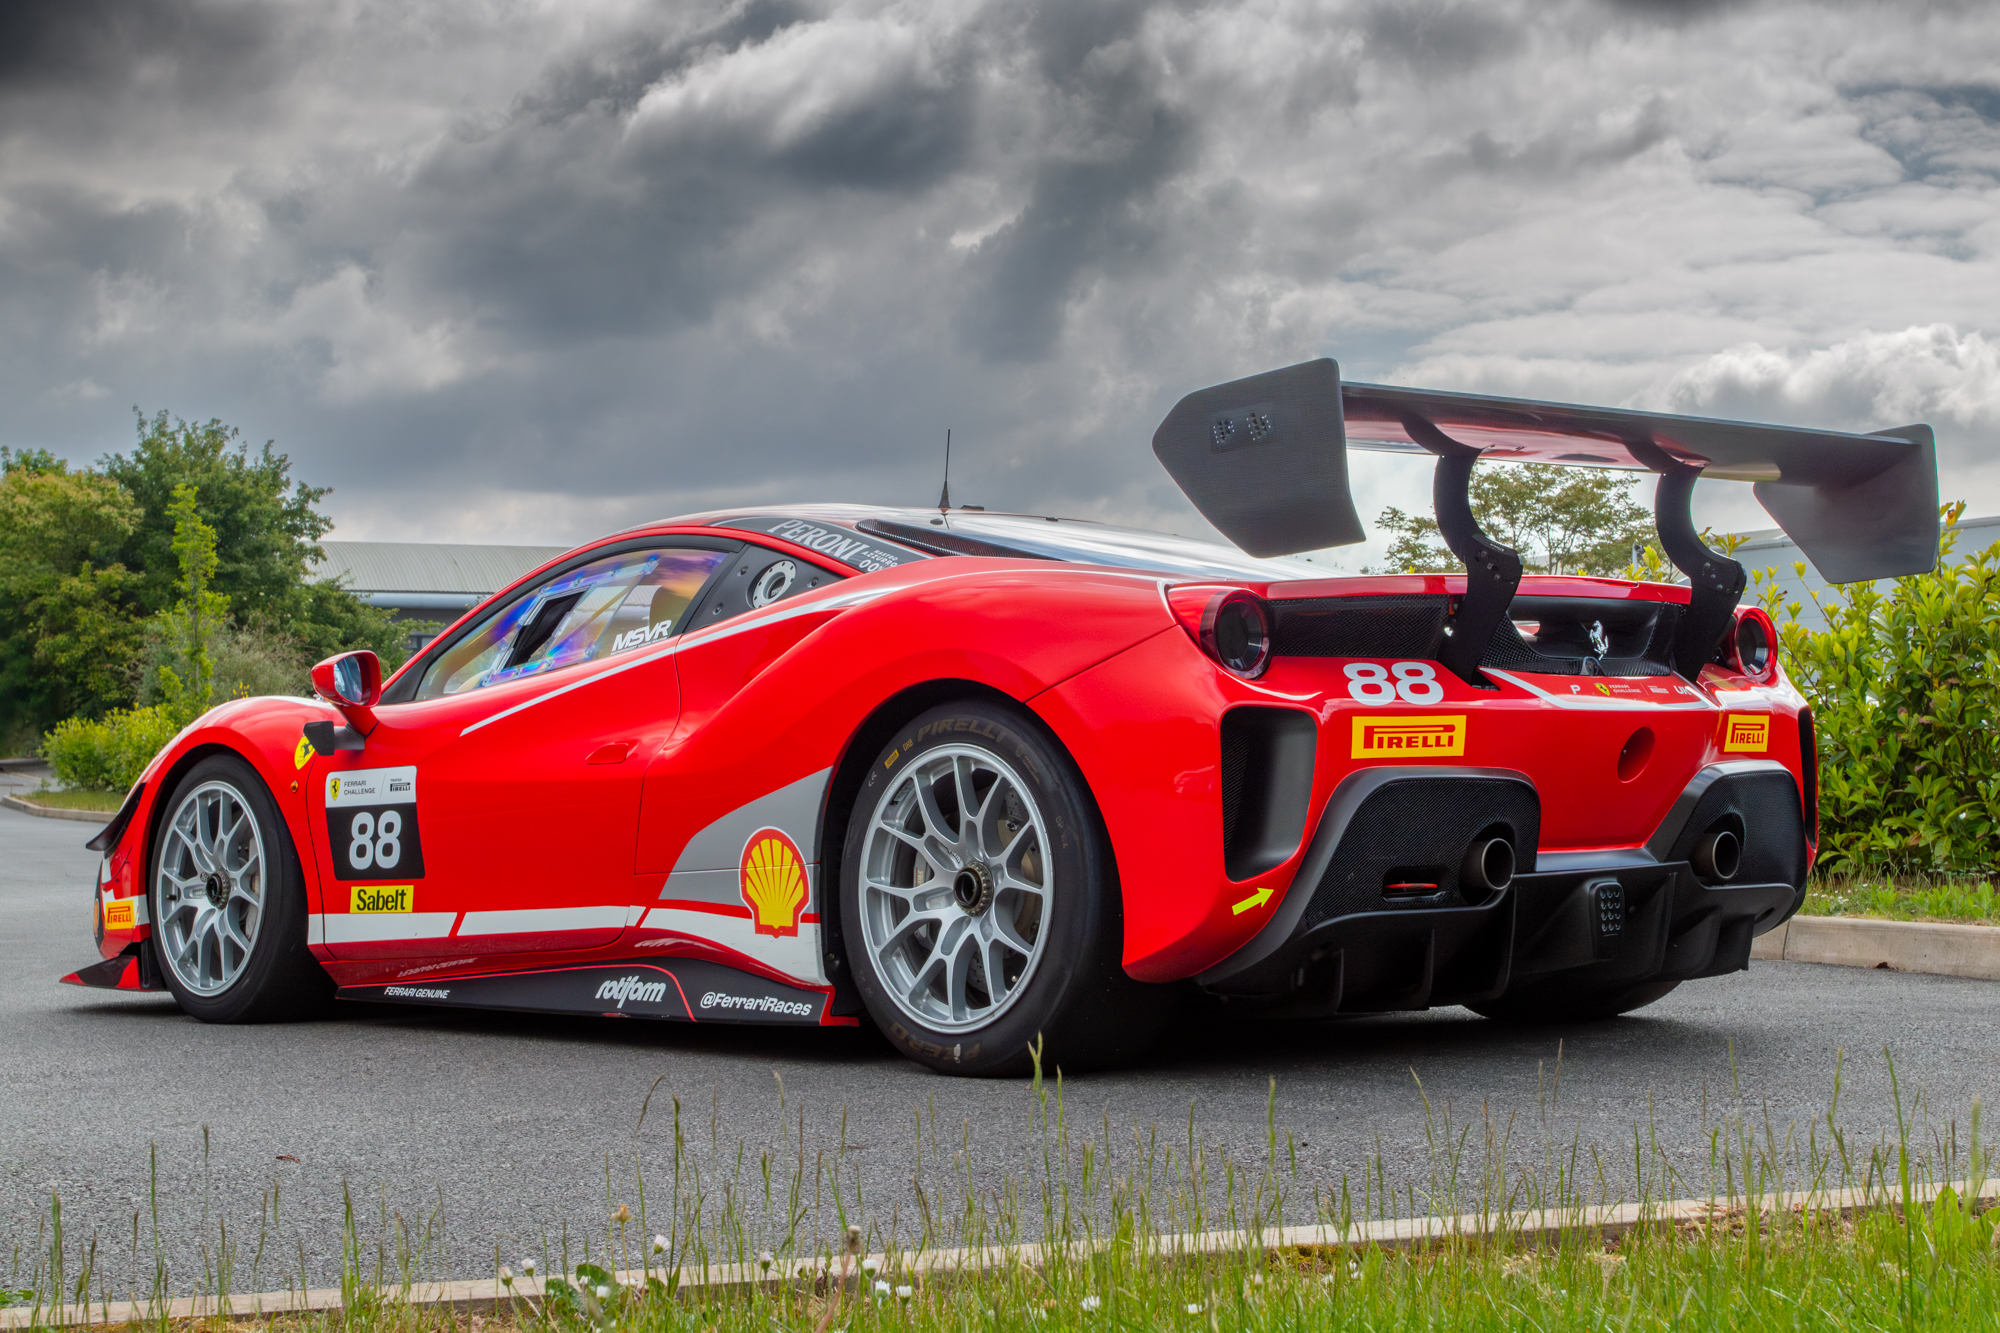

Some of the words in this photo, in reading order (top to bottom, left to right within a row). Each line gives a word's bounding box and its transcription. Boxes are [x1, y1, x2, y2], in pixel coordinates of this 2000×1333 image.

[767, 519, 870, 561] PERONI
[861, 551, 898, 567] AZZURRO
[611, 619, 672, 652] MSVR
[1343, 661, 1444, 706] 88
[1570, 684, 1581, 694] P
[917, 718, 1007, 743] PIRELLI
[1363, 724, 1456, 749] PIRELLI
[1730, 722, 1765, 744] PIRELLI
[344, 780, 367, 788] FERRARI
[344, 787, 376, 795] CHALLENGE
[390, 782, 411, 792] PIRELLI
[349, 810, 402, 870] 88
[356, 888, 406, 911] Sabelt
[107, 905, 131, 924] PIRELLI
[384, 986, 416, 997] FERRARI
[415, 988, 450, 999] GENUINE
[595, 976, 667, 1009] rotiform
[700, 991, 812, 1016] @FerrariRaces
